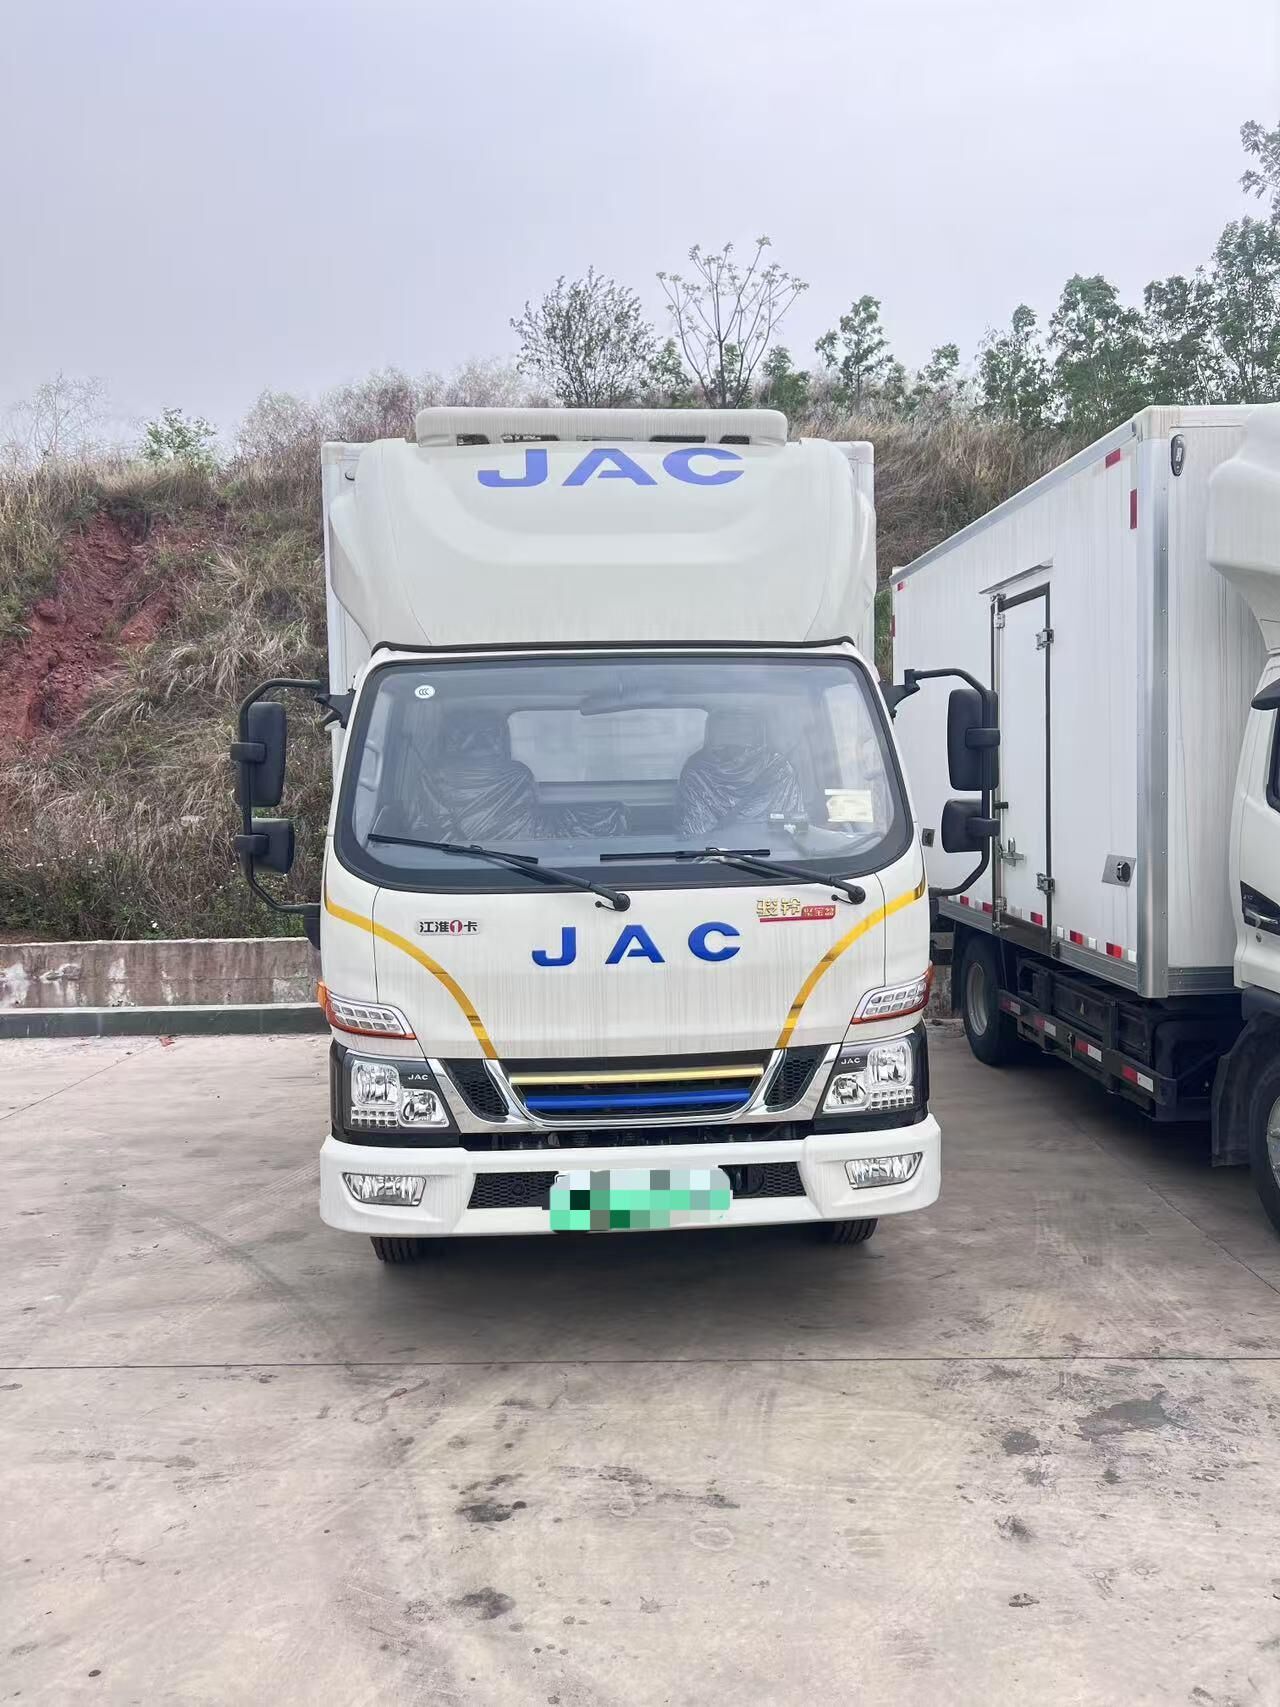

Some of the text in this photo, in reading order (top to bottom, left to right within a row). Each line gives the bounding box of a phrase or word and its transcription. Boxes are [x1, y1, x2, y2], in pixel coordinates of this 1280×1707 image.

[477, 447, 745, 488] JAC
[531, 921, 741, 967] JAC
[840, 1057, 861, 1065] JAC
